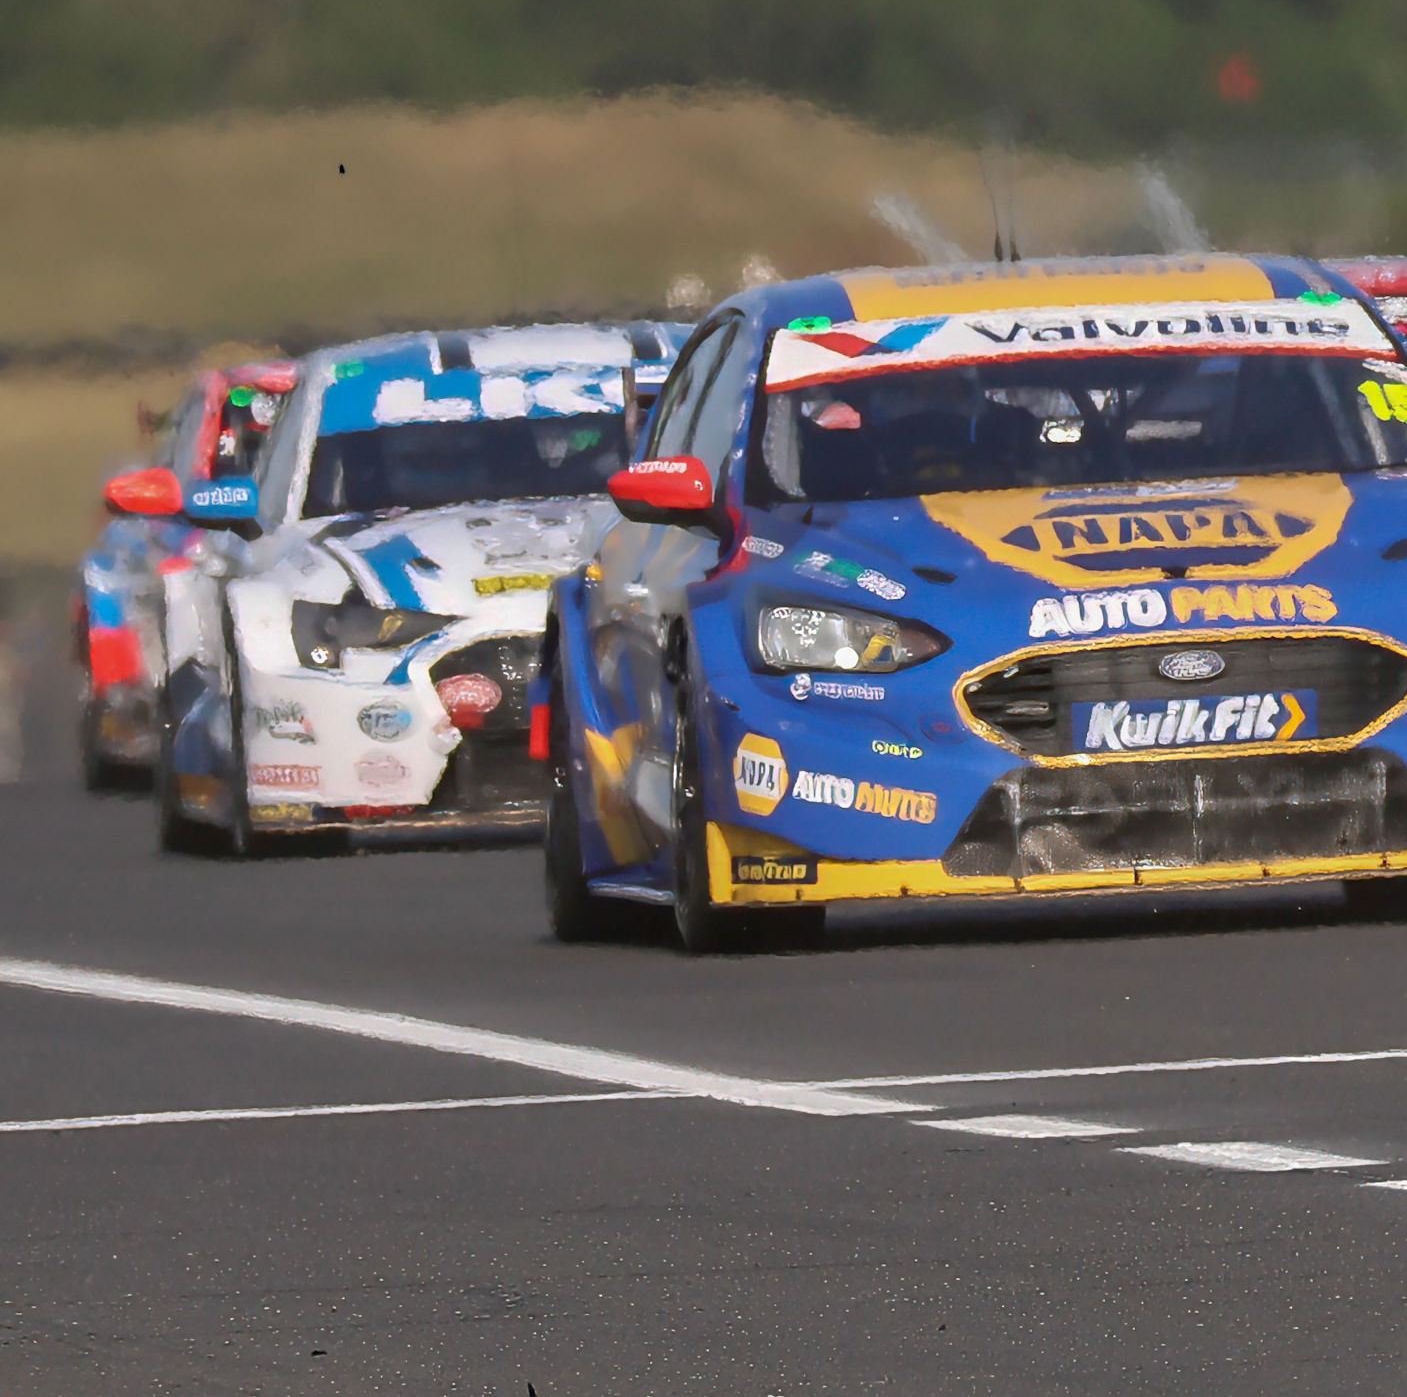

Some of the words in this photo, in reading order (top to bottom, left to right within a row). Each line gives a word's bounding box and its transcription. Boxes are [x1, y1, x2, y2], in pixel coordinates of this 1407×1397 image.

[963, 312, 1351, 344] Valvoline
[1052, 509, 1271, 550] NAPA
[1028, 587, 1168, 639] AUTO
[1170, 584, 1339, 624] PARTS
